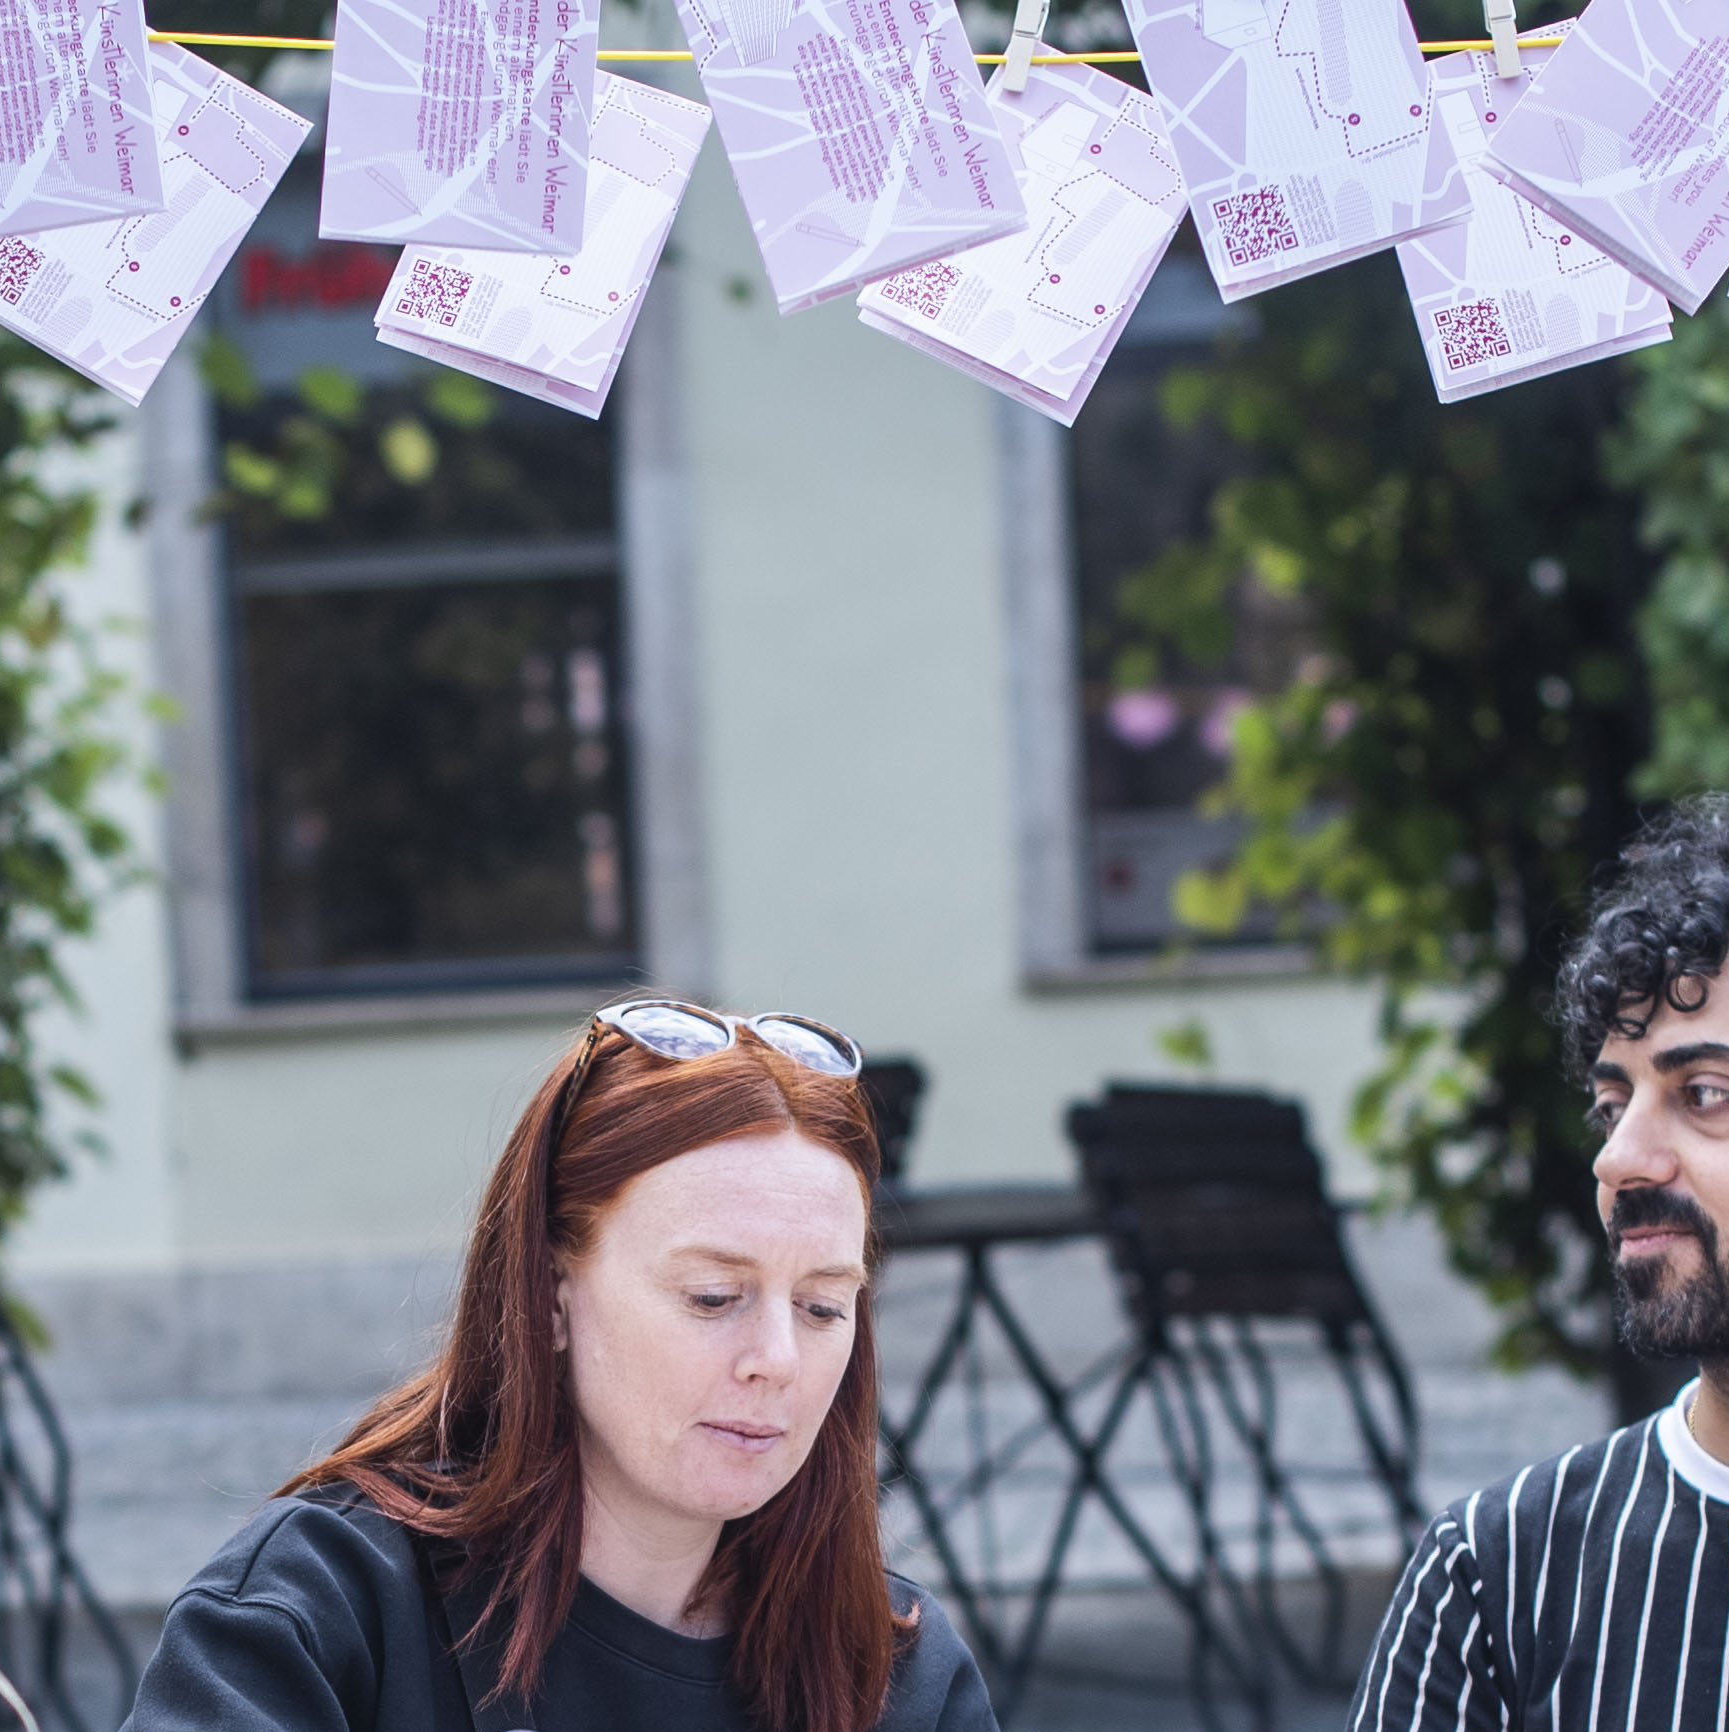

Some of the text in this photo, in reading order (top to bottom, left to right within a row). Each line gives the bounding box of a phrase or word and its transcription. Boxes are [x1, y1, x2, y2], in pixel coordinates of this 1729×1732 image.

[42, 32, 70, 161] durch Weimar ein!
[57, 31, 77, 116] alternativen
[96, 2, 137, 196] Künstlerinnen Weimar
[493, 54, 507, 95] durch
[505, 7, 525, 142] einem alternativen
[863, 2, 920, 145] zu einem alternativen
[878, 0, 948, 176] Entdeckungskarte lädt Sie
[81, 100, 95, 128] lädt
[488, 99, 503, 155] Weimar
[541, 1, 579, 234] der Künstlerinnen Weimar
[871, 69, 893, 109] durch
[886, 109, 911, 162] Weimar
[905, 165, 922, 191] ein!
[909, 0, 995, 210] der Künstlerinnen Weimar
[85, 131, 98, 153] Sie
[517, 130, 531, 158] lädt
[1705, 138, 1717, 155] of
[485, 158, 499, 184] ein!
[516, 161, 529, 183] Sie
[1668, 153, 1709, 203] Weimar!
[1685, 180, 1705, 207] you
